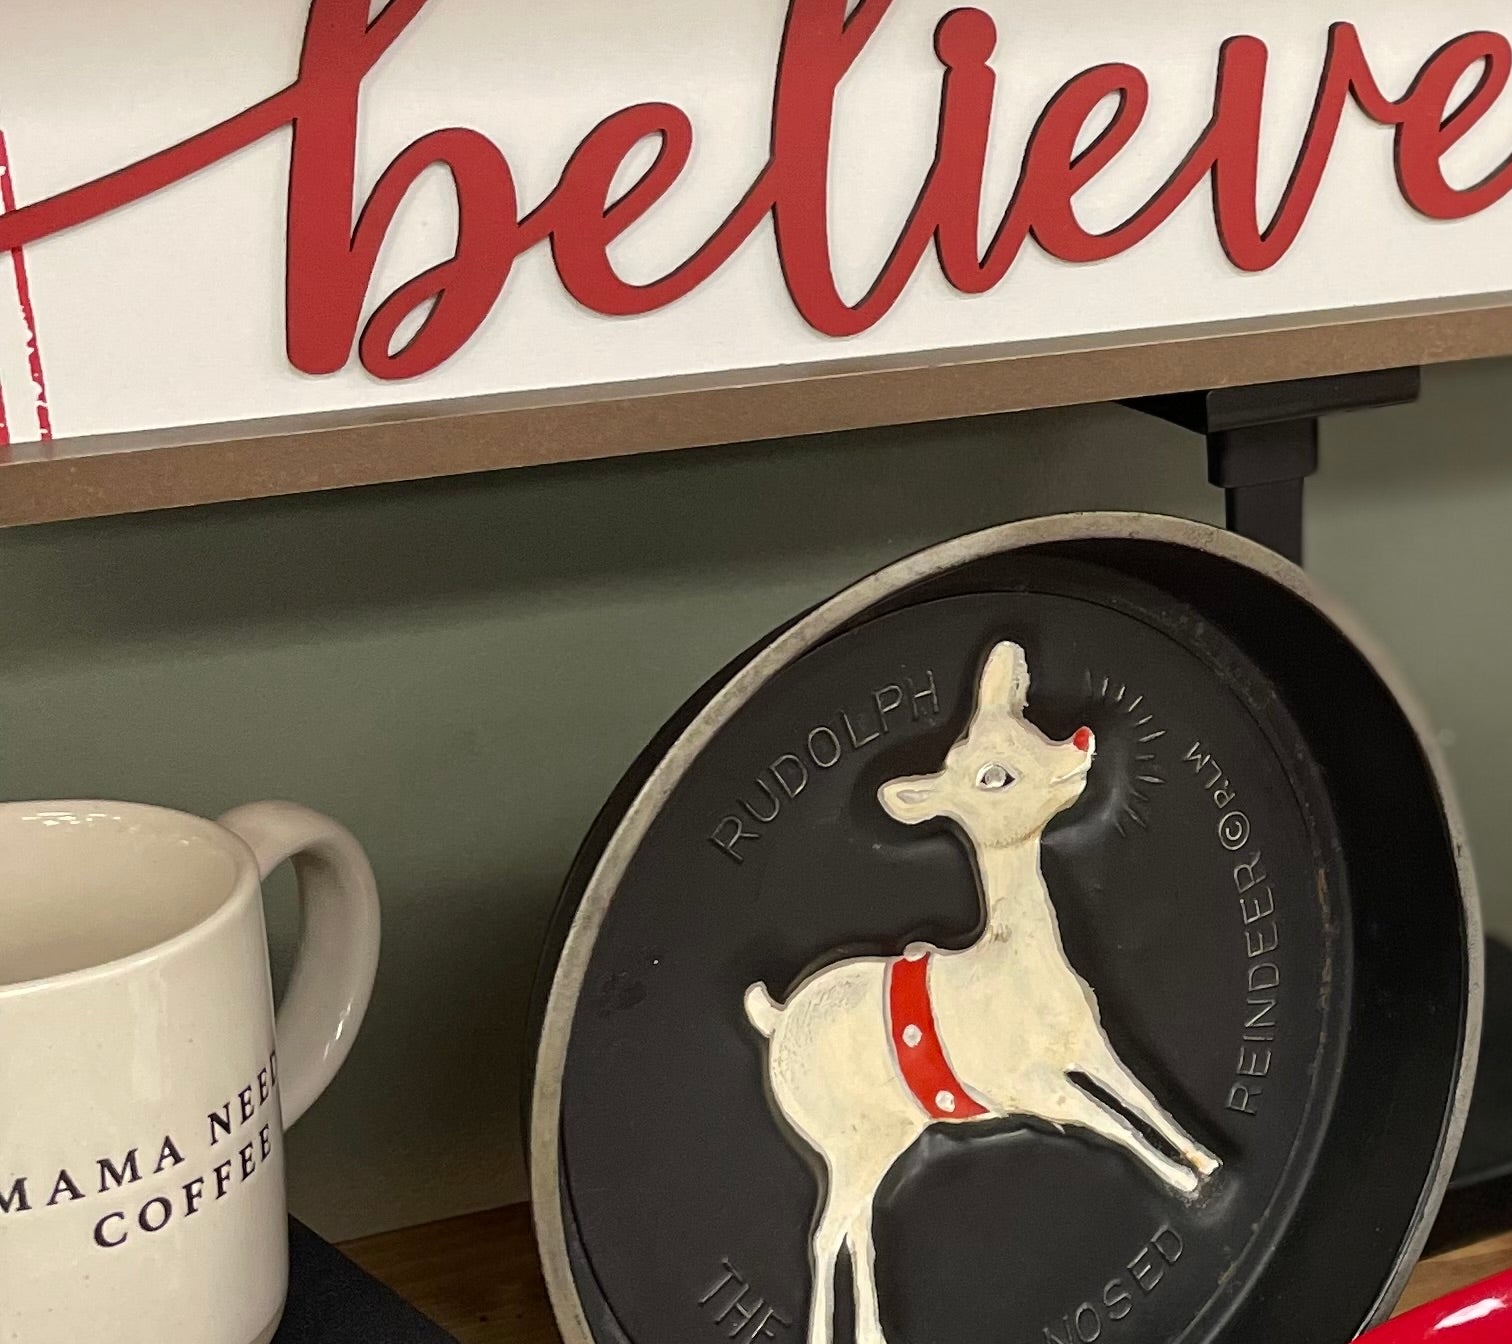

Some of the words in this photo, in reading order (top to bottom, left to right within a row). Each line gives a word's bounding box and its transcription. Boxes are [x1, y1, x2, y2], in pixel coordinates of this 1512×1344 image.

[708, 669, 940, 864] RUDOLPH
[1225, 850, 1280, 1116] REINDEER
[0, 1135, 186, 1214] MAMA
[93, 1122, 273, 1248] COFFEE
